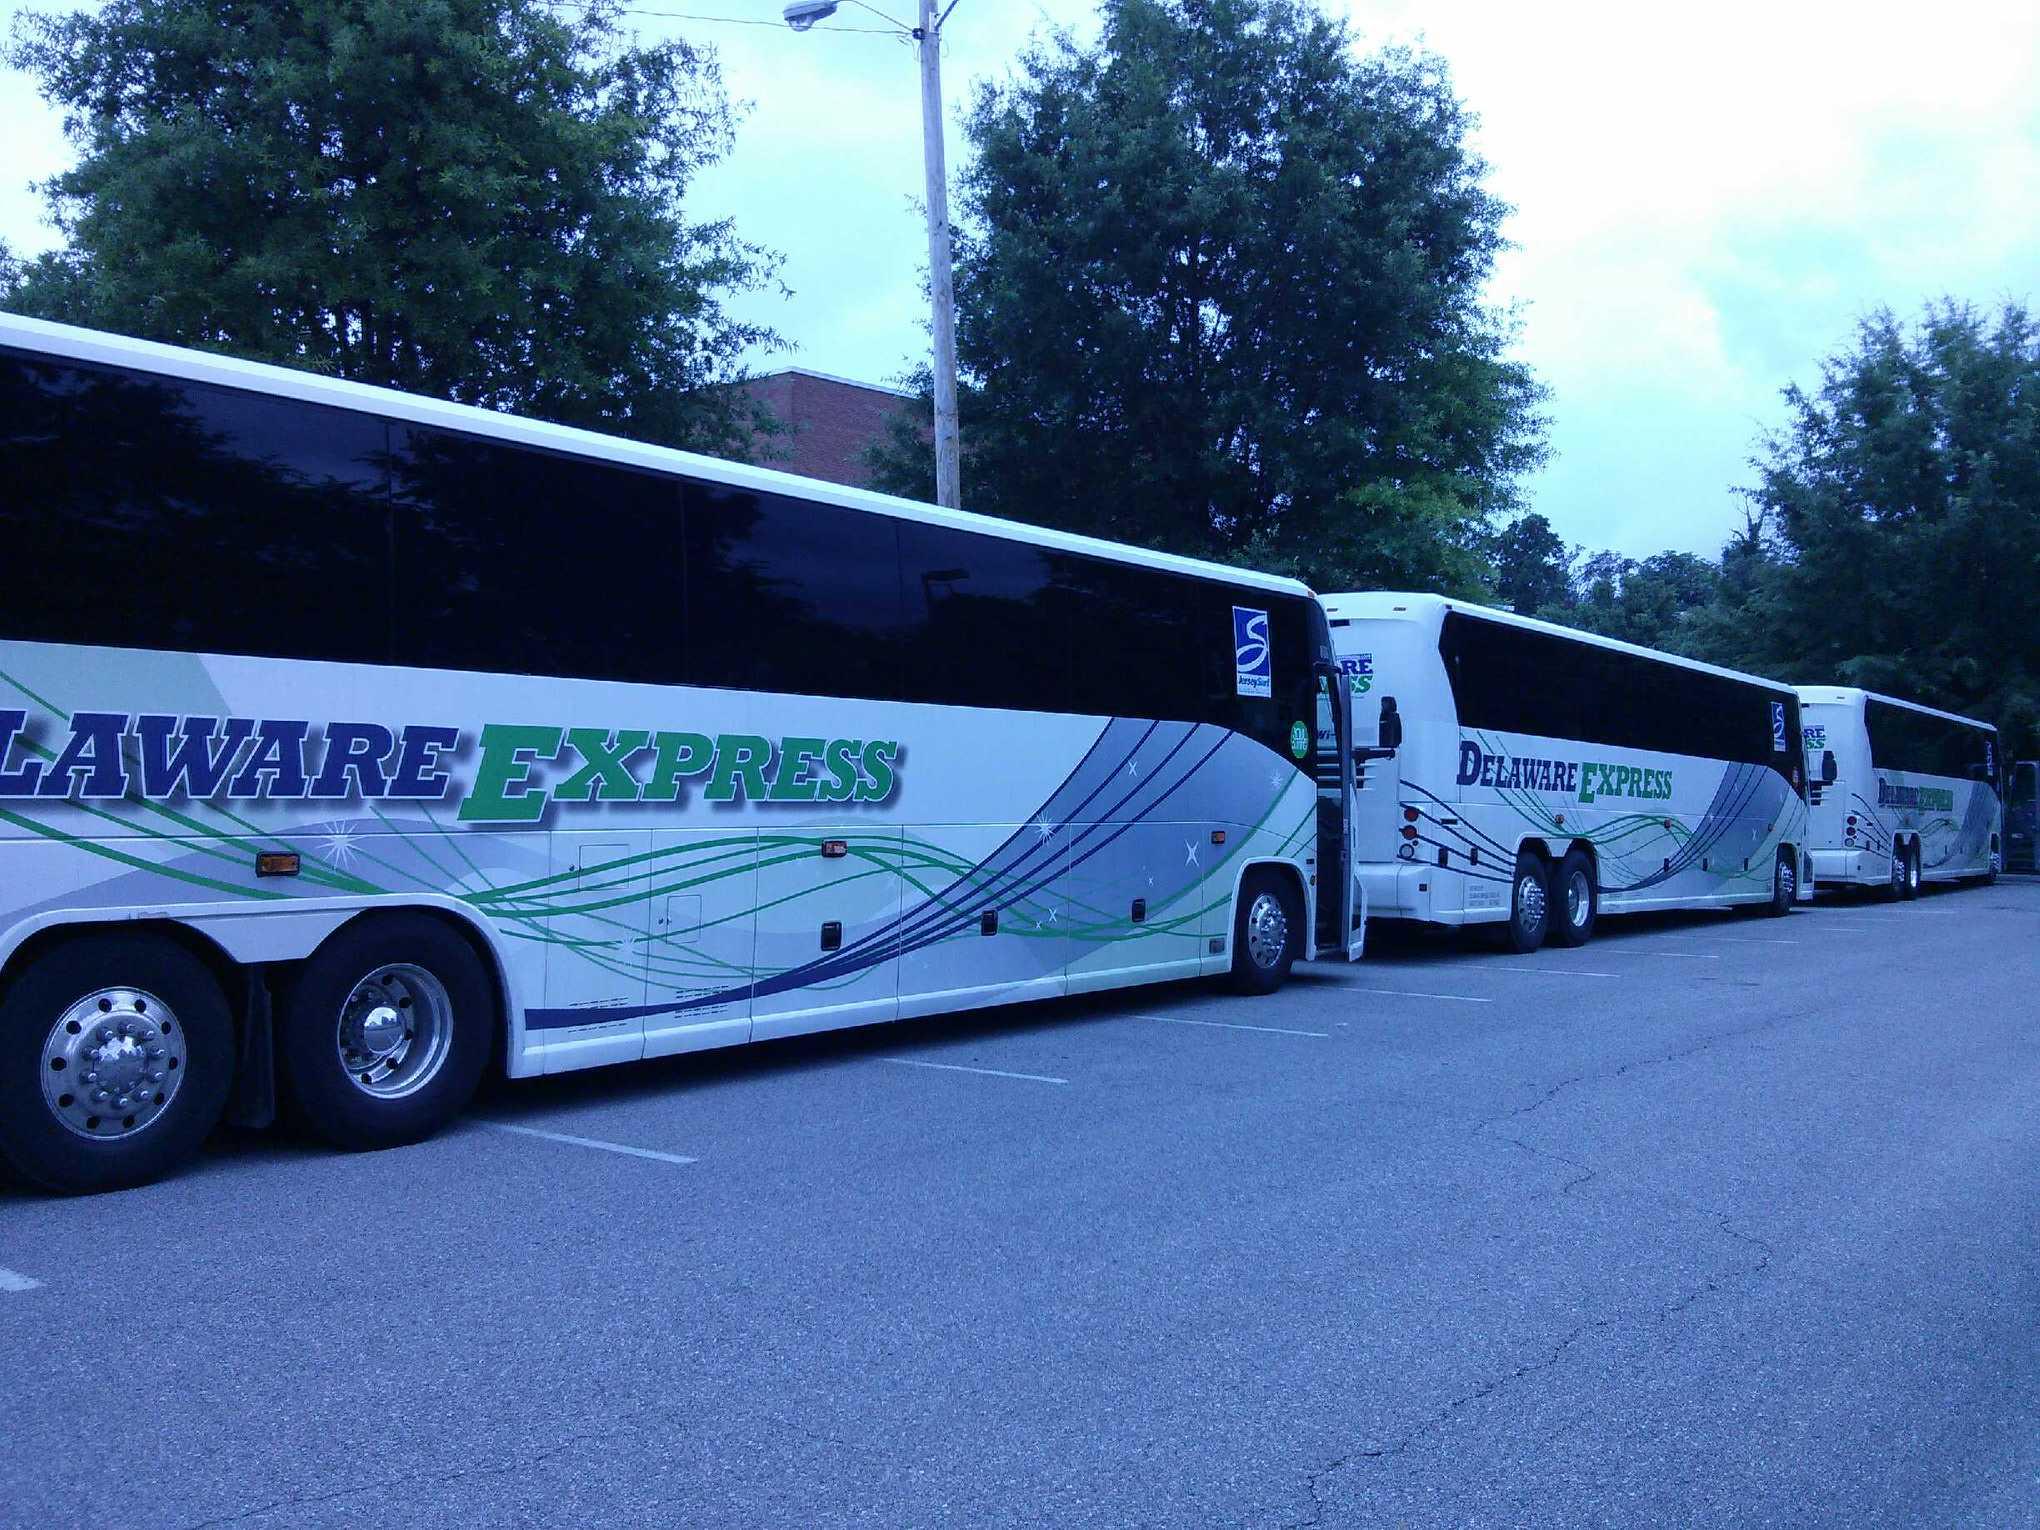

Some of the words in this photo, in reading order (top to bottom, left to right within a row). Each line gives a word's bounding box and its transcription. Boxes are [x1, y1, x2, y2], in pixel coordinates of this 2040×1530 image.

[456, 723, 898, 823] EXPRESS
[1456, 740, 1579, 793] DELAWARE
[1578, 761, 1673, 804] EXPRESS
